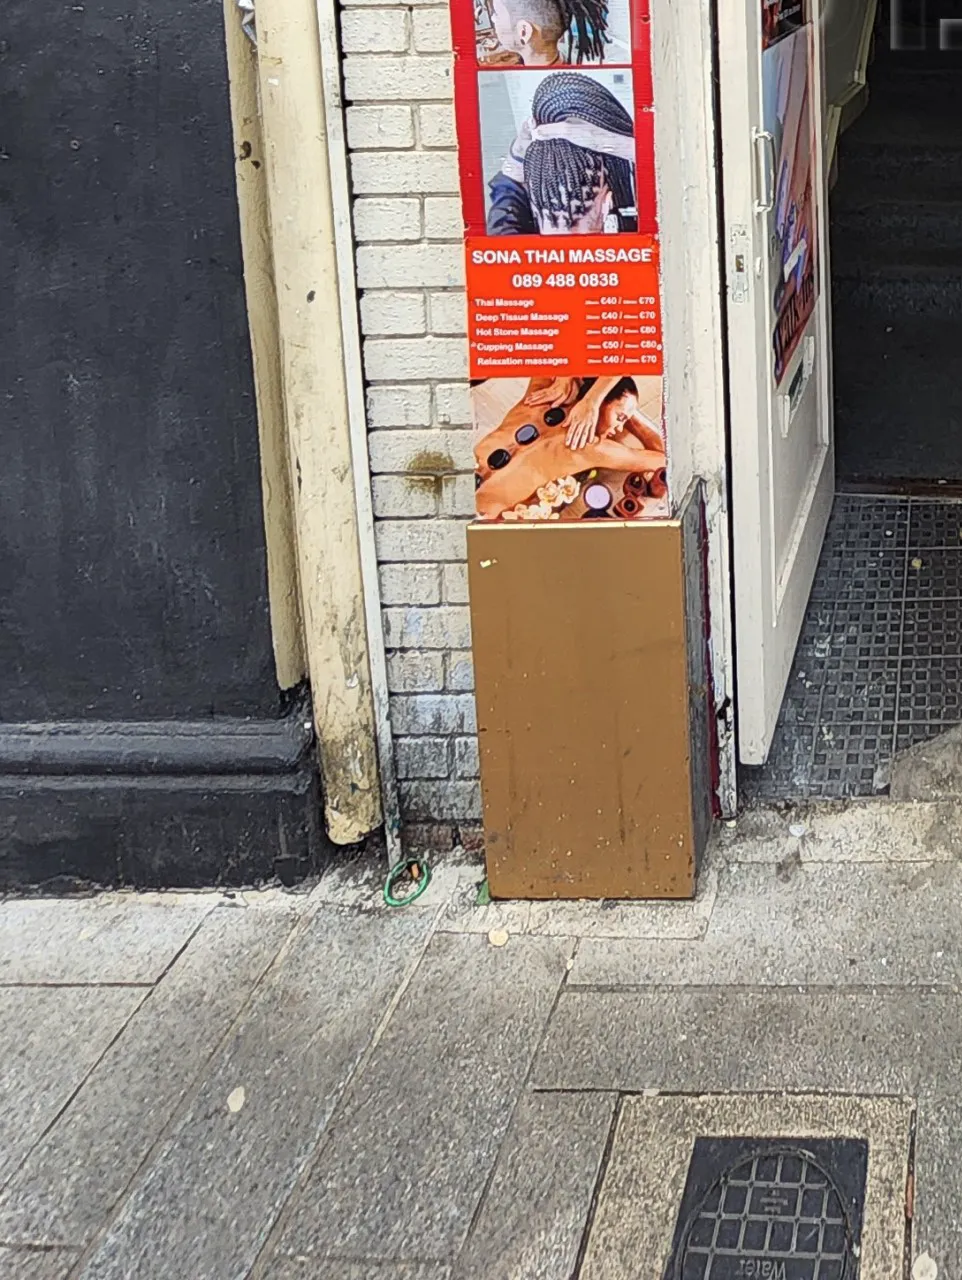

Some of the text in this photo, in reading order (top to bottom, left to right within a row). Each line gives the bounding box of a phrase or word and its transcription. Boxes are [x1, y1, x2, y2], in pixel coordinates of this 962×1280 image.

[472, 248, 652, 264] SONA THAI MASSAGE
[512, 273, 619, 288] 089 488 0838
[475, 298, 494, 307] Thai
[495, 298, 534, 308] Massage
[475, 314, 499, 323] Deep
[500, 313, 529, 321] Tissue
[530, 313, 569, 322] Massage
[476, 328, 492, 336] Hot
[494, 328, 519, 336] Stone
[520, 328, 560, 337] Massage
[477, 343, 514, 352] Cupping
[515, 342, 554, 352] Massage
[477, 357, 523, 365] Relaxation
[524, 357, 569, 366] massages
